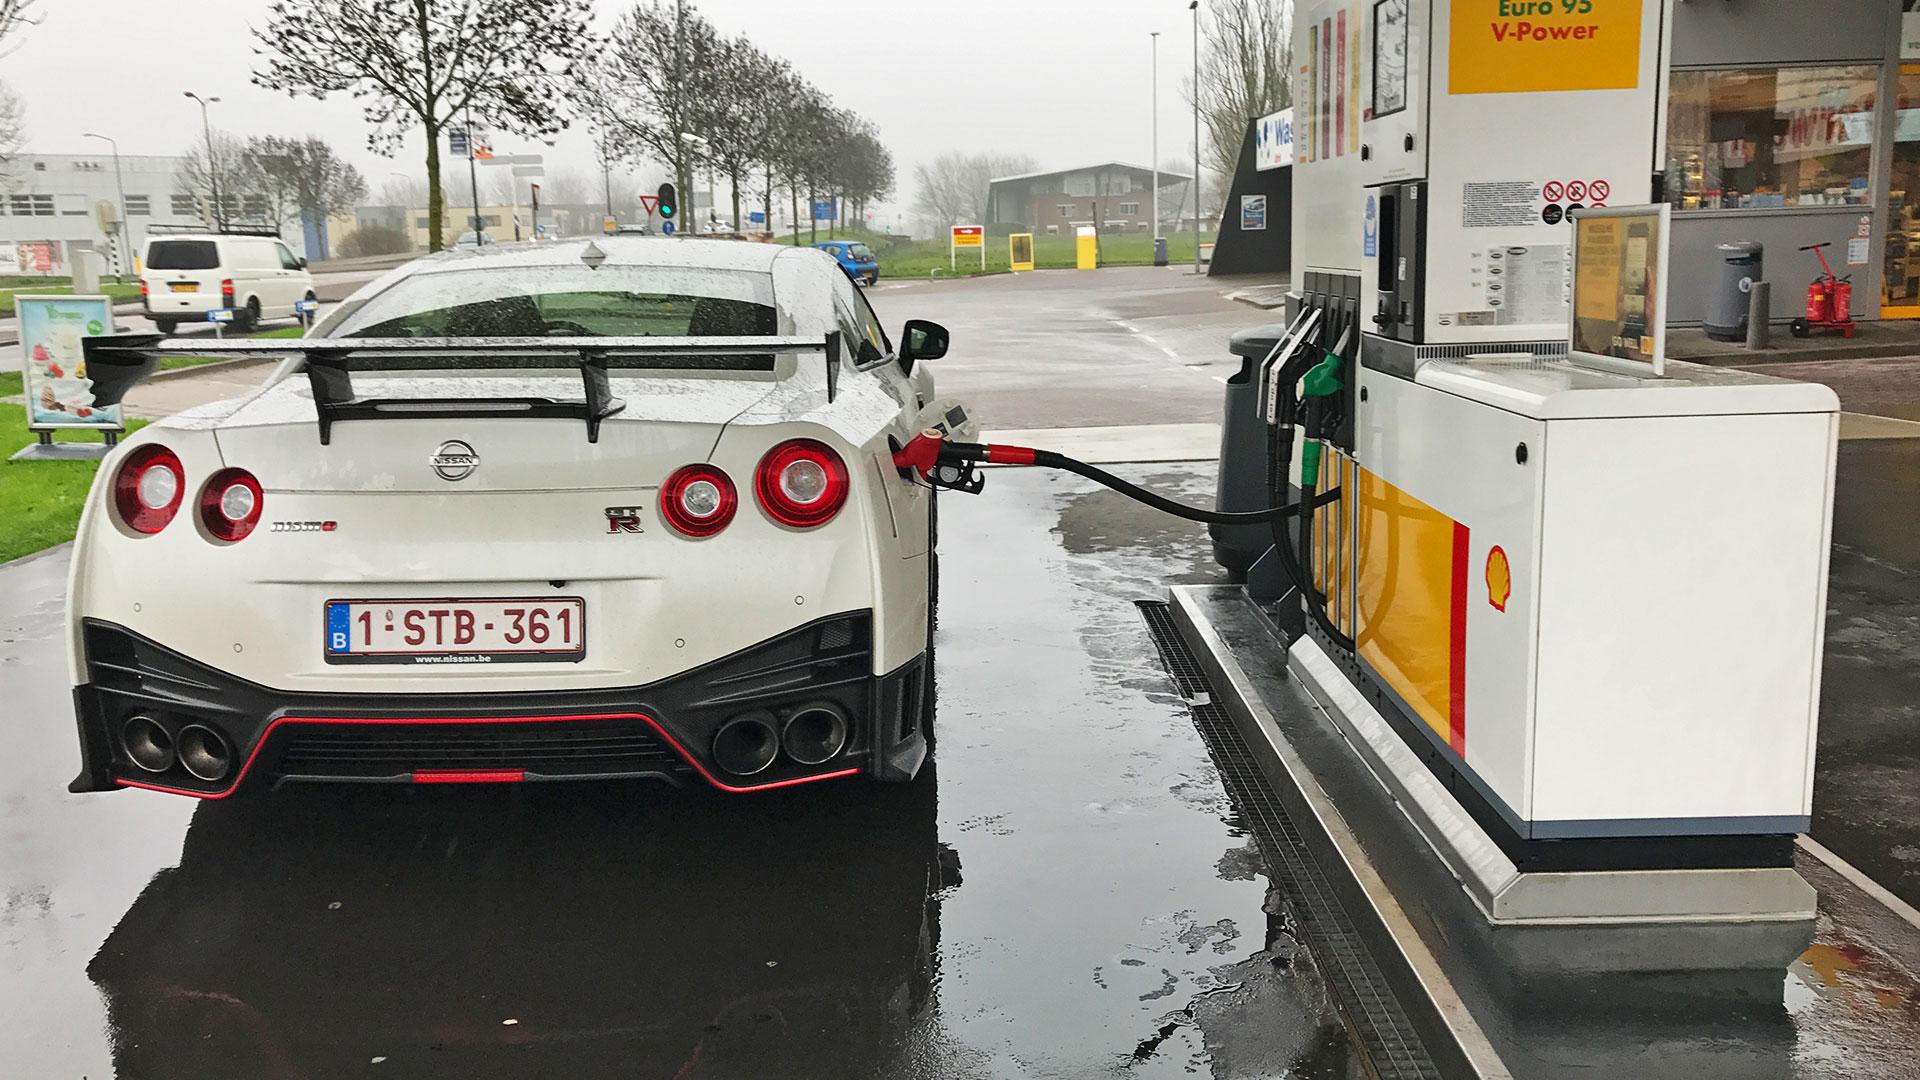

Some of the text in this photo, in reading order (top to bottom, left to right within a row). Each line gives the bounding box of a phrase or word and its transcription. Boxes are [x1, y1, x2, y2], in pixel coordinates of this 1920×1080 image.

[1499, 0, 1593, 17] Euro 95
[1491, 22, 1599, 42] V-Power
[433, 456, 474, 465] NISSAN
[332, 632, 347, 649] B
